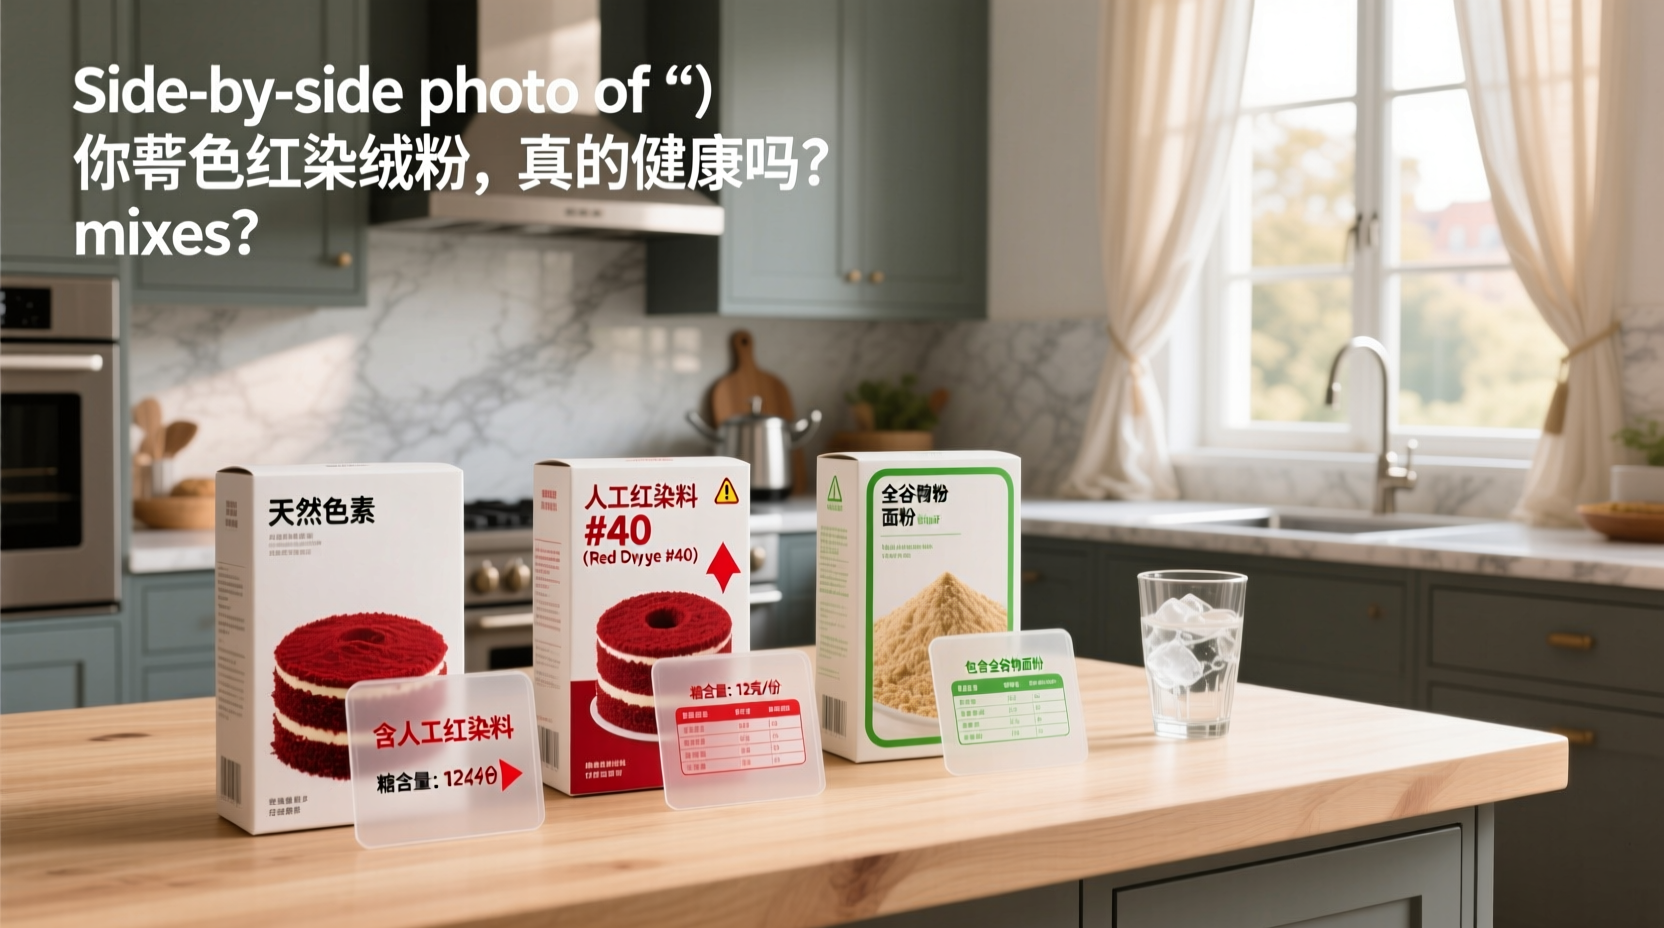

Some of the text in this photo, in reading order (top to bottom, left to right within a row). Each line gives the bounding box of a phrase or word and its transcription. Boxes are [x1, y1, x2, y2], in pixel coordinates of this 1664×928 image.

[268, 495, 376, 527] 天然色素
[584, 482, 698, 510] 人工红染料
[584, 513, 652, 546] #40
[583, 549, 617, 567] (Red
[665, 547, 698, 565] #40)
[373, 714, 514, 749] 含人工红染料
